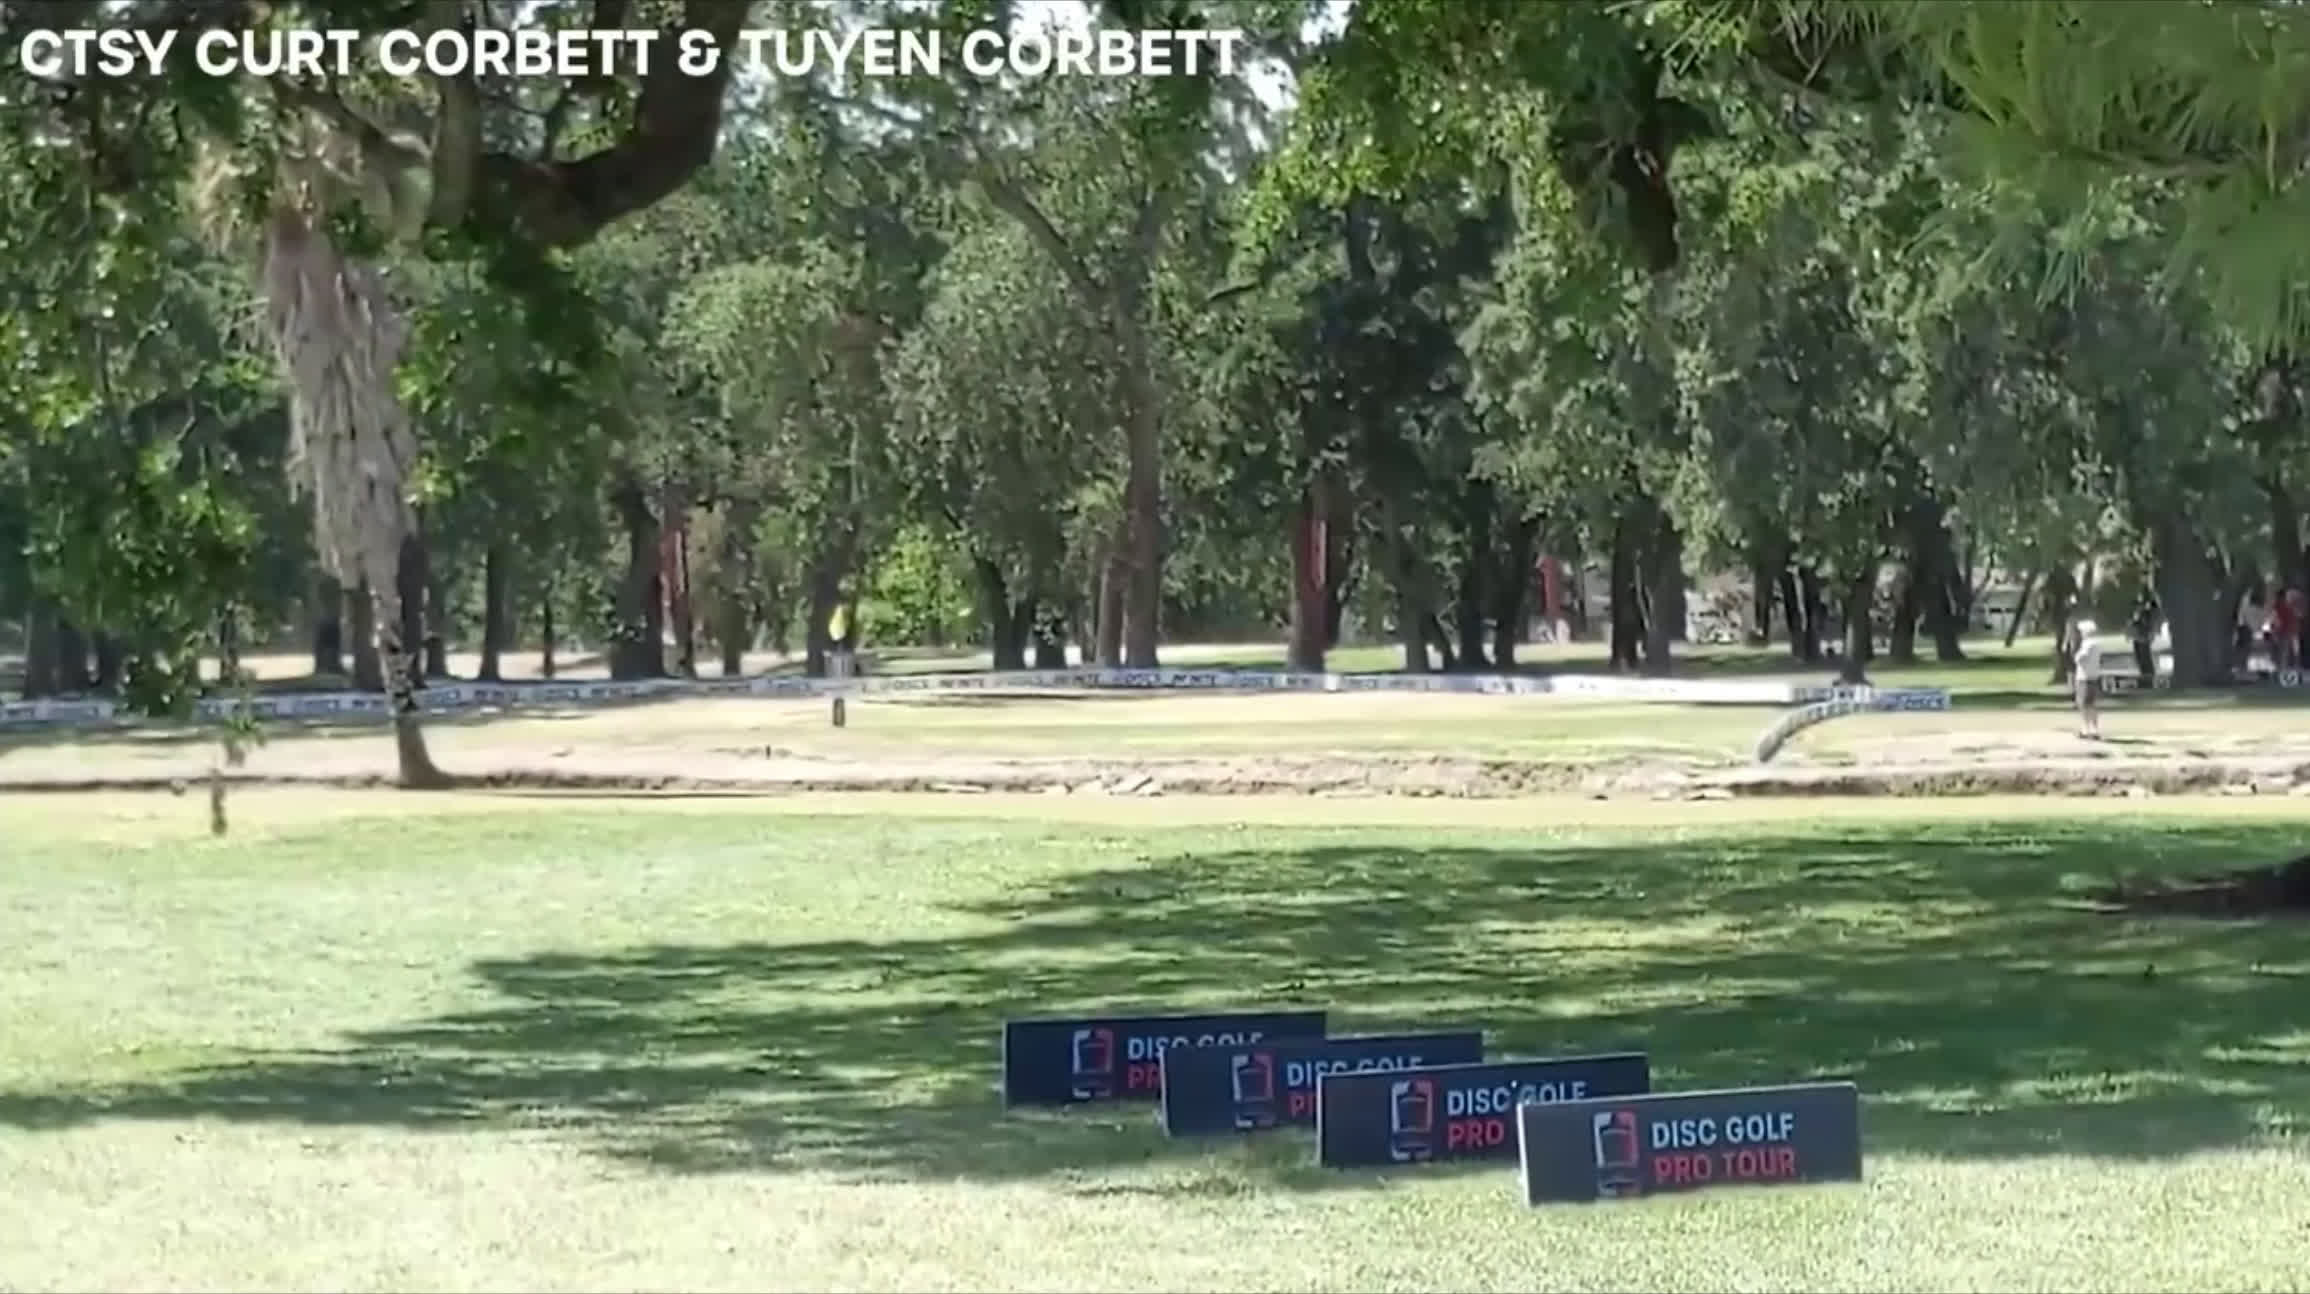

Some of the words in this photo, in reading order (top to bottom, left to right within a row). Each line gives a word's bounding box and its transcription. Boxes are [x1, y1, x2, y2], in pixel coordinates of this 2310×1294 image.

[1128, 1062, 1160, 1089] PR
[1447, 1086, 1511, 1116] DISC
[1516, 1081, 1587, 1105] GOLF
[1448, 1118, 1504, 1148] PRO
[1651, 1117, 1718, 1149] DISC
[1725, 1112, 1795, 1143] GOLF
[1655, 1153, 1713, 1184] PRO
[1721, 1147, 1796, 1177] TOUR
